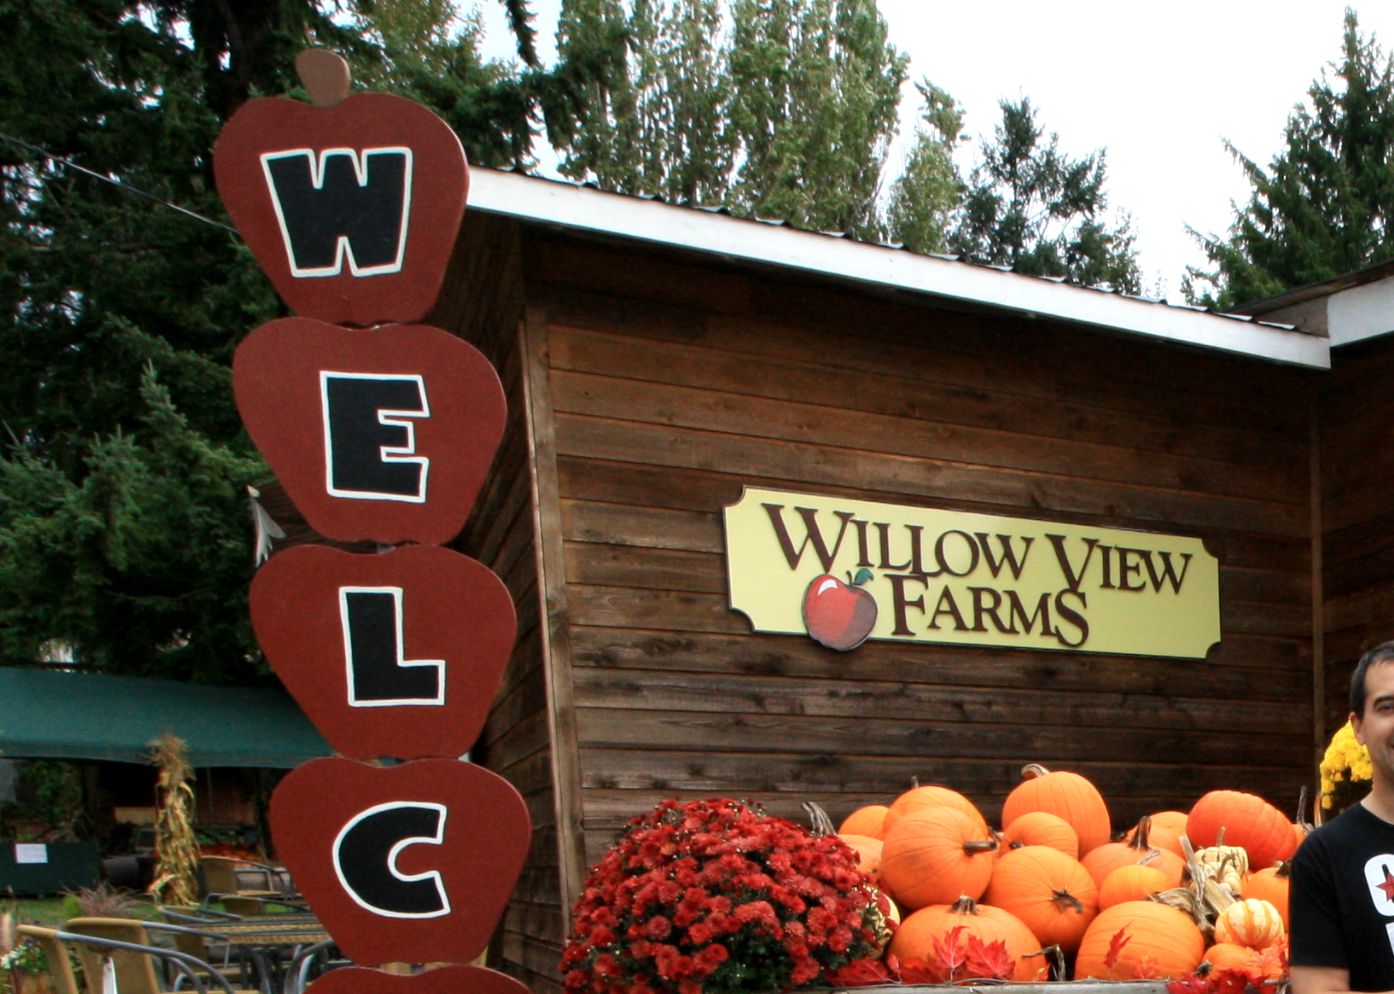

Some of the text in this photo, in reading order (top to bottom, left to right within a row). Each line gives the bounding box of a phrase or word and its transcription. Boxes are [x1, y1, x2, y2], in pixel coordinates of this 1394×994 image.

[761, 502, 1193, 595] WILLOW VIEW
[884, 572, 1090, 648] FARMS
